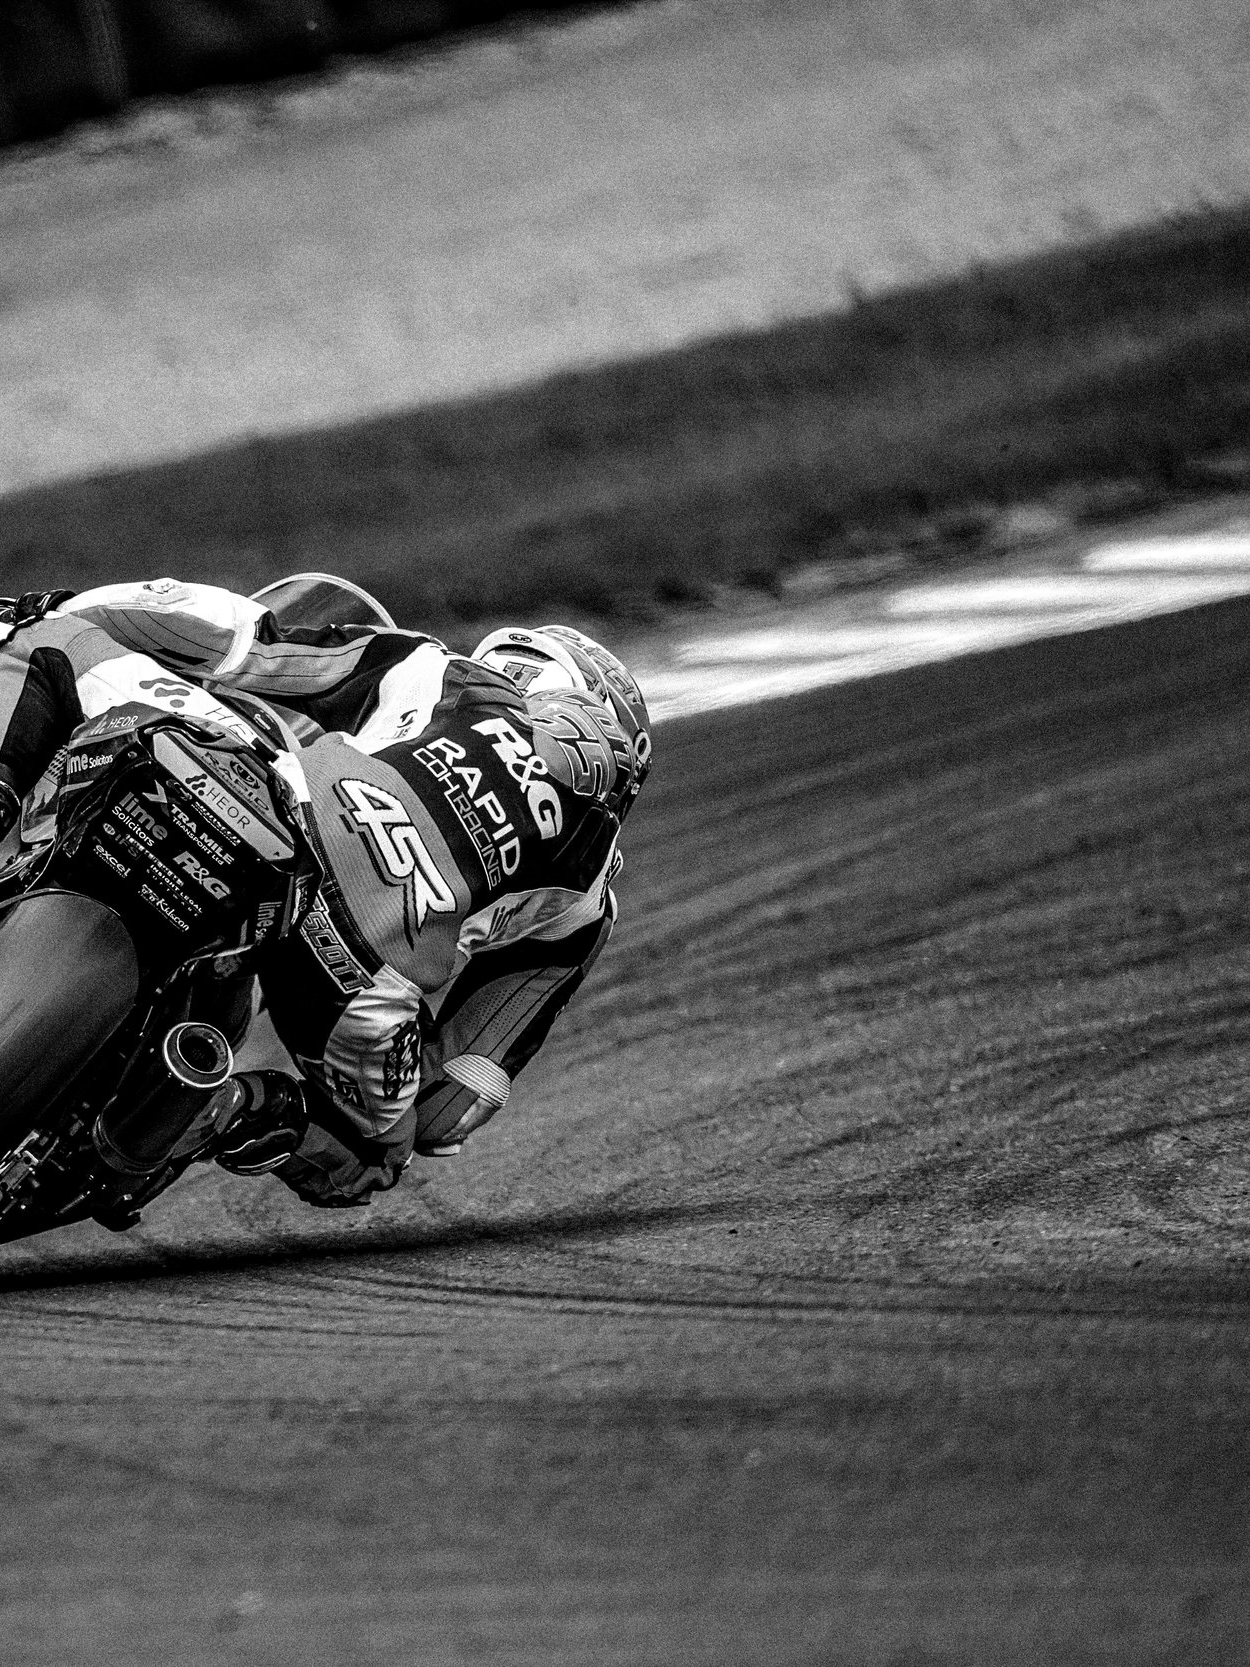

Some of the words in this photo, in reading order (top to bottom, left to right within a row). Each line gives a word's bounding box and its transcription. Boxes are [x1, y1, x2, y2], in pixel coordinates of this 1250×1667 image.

[107, 715, 138, 729] HEOR
[201, 752, 269, 811] RAPID
[470, 717, 563, 840] R&G
[111, 805, 155, 847] Solicitors
[119, 791, 168, 841] lime
[206, 787, 250, 829] HEOR
[412, 748, 460, 797] COH
[453, 792, 502, 888] RACING
[426, 737, 521, 876] RAPID
[172, 815, 213, 854] TRANSPORT
[199, 832, 235, 865] MILE
[95, 844, 132, 877] excel
[173, 850, 231, 900] R&G
[180, 891, 203, 914] LEGAL
[256, 901, 282, 927] lime
[301, 911, 374, 991] SCOTT
